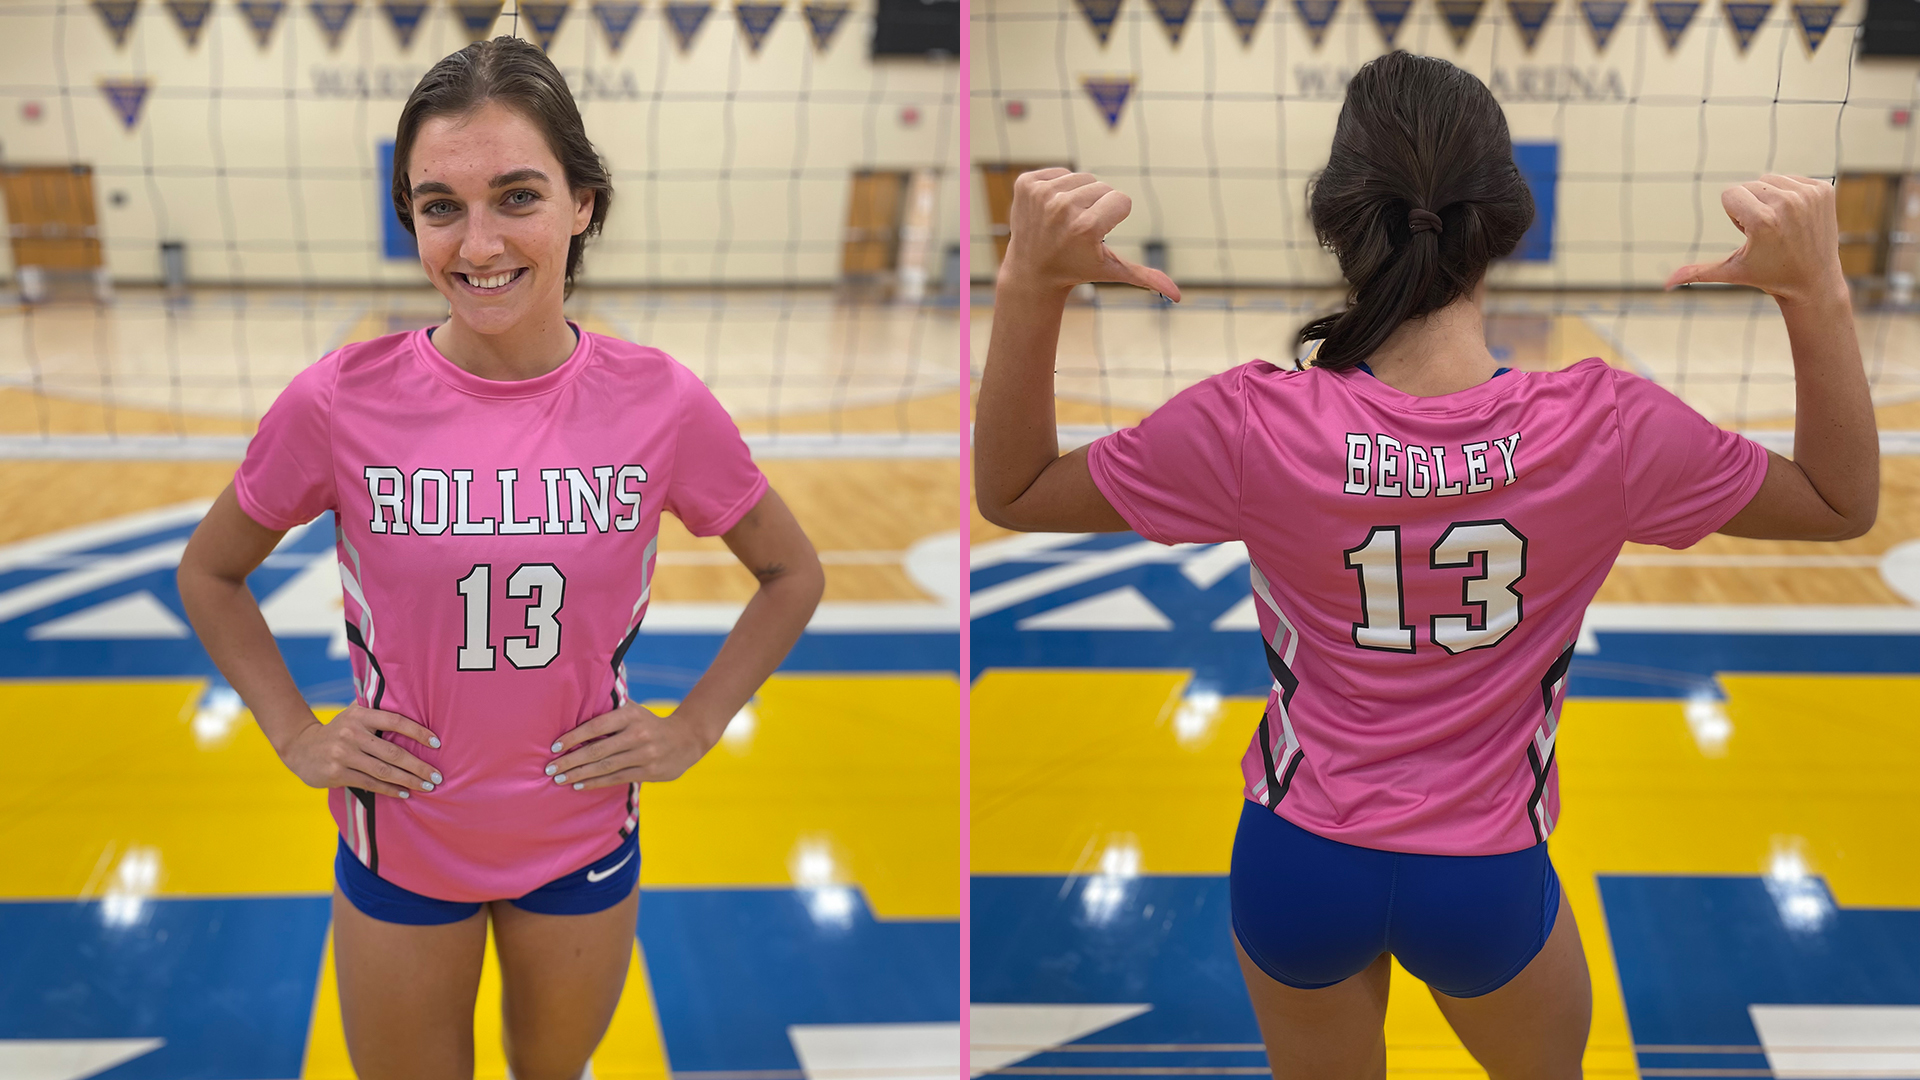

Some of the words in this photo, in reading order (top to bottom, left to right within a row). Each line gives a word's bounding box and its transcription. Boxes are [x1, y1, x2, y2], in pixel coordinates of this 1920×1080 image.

[1489, 64, 1627, 103] ARENA
[364, 464, 648, 535] ROLLINS
[1343, 431, 1521, 498] BEGLEY
[456, 563, 567, 671] 13
[1343, 518, 1529, 656] 13
